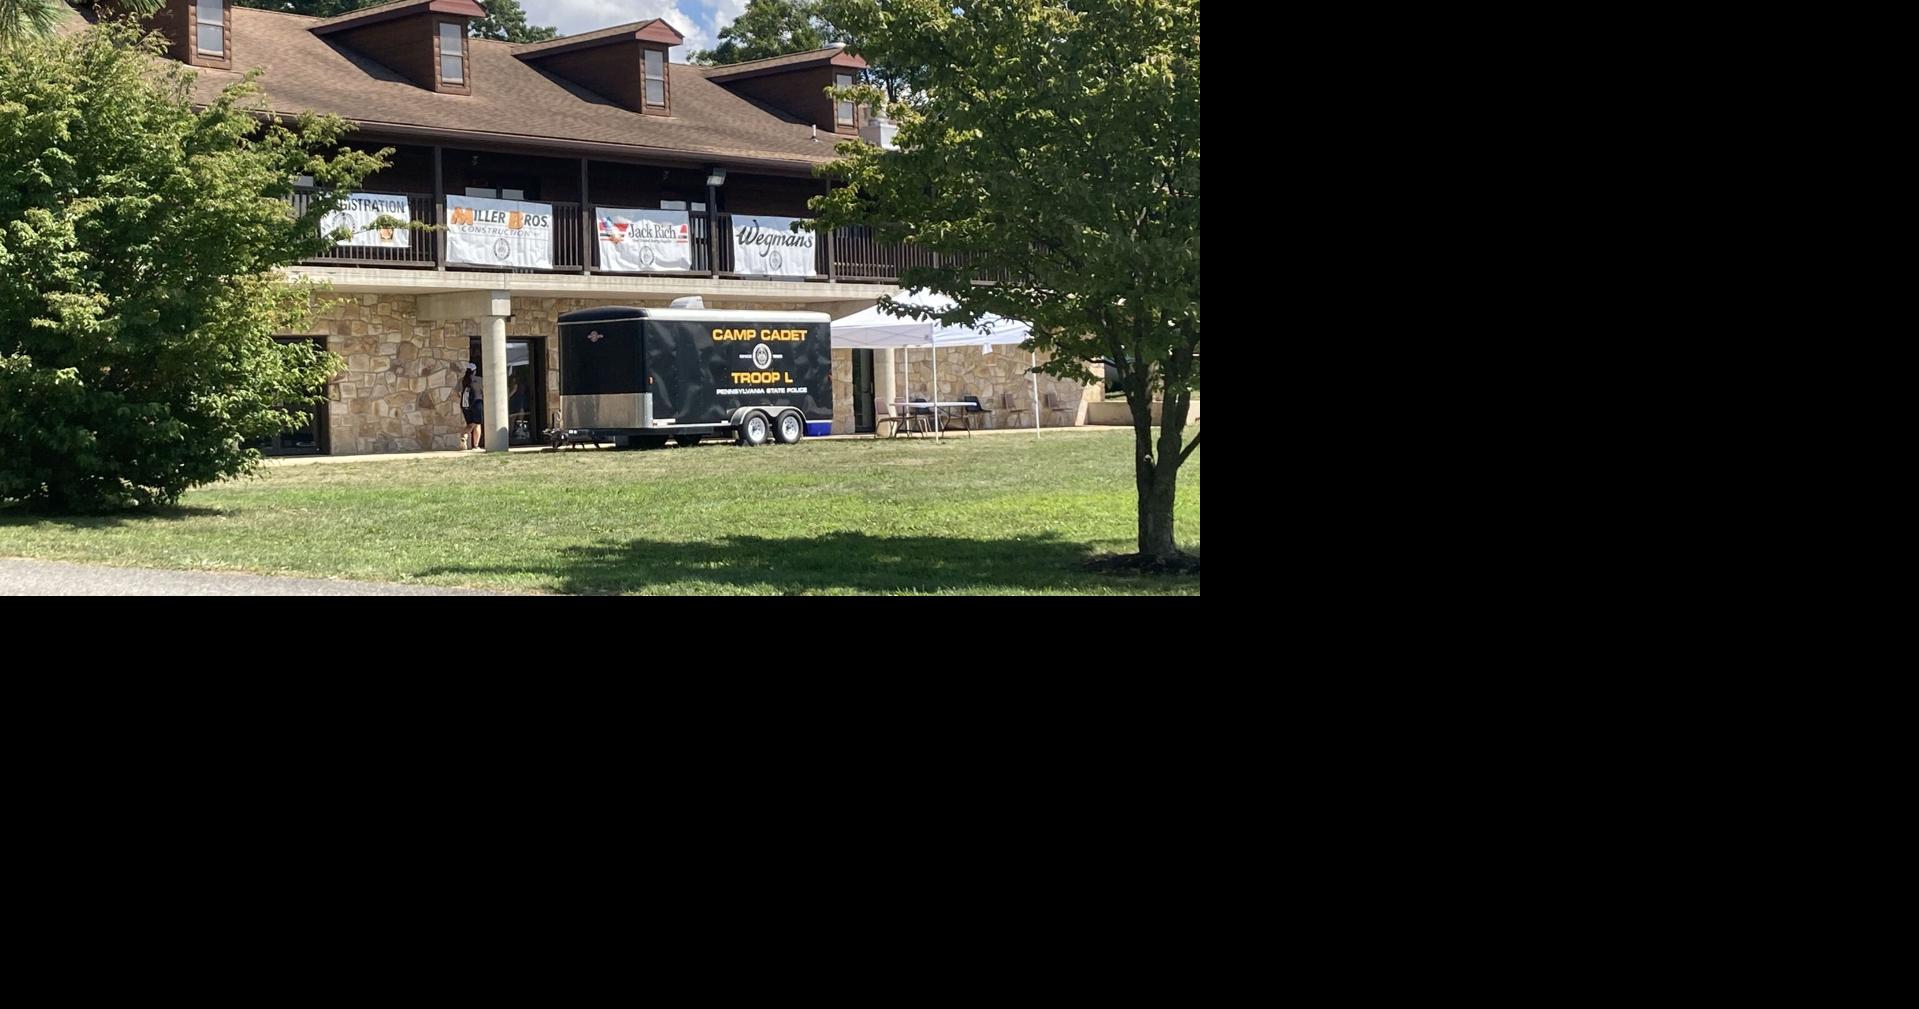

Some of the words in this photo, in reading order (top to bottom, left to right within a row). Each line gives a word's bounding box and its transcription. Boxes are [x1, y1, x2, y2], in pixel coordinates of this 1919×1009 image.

[451, 207, 506, 225] MILLER
[508, 211, 549, 229] BROS.
[461, 225, 530, 237] CONSTRUCTION
[628, 223, 653, 238] Jack
[654, 223, 676, 239] Rich
[736, 219, 813, 257] Wegmans
[712, 329, 757, 341] CAMP
[760, 329, 808, 341] CADET
[731, 372, 781, 384] TROOP
[784, 372, 794, 383] L
